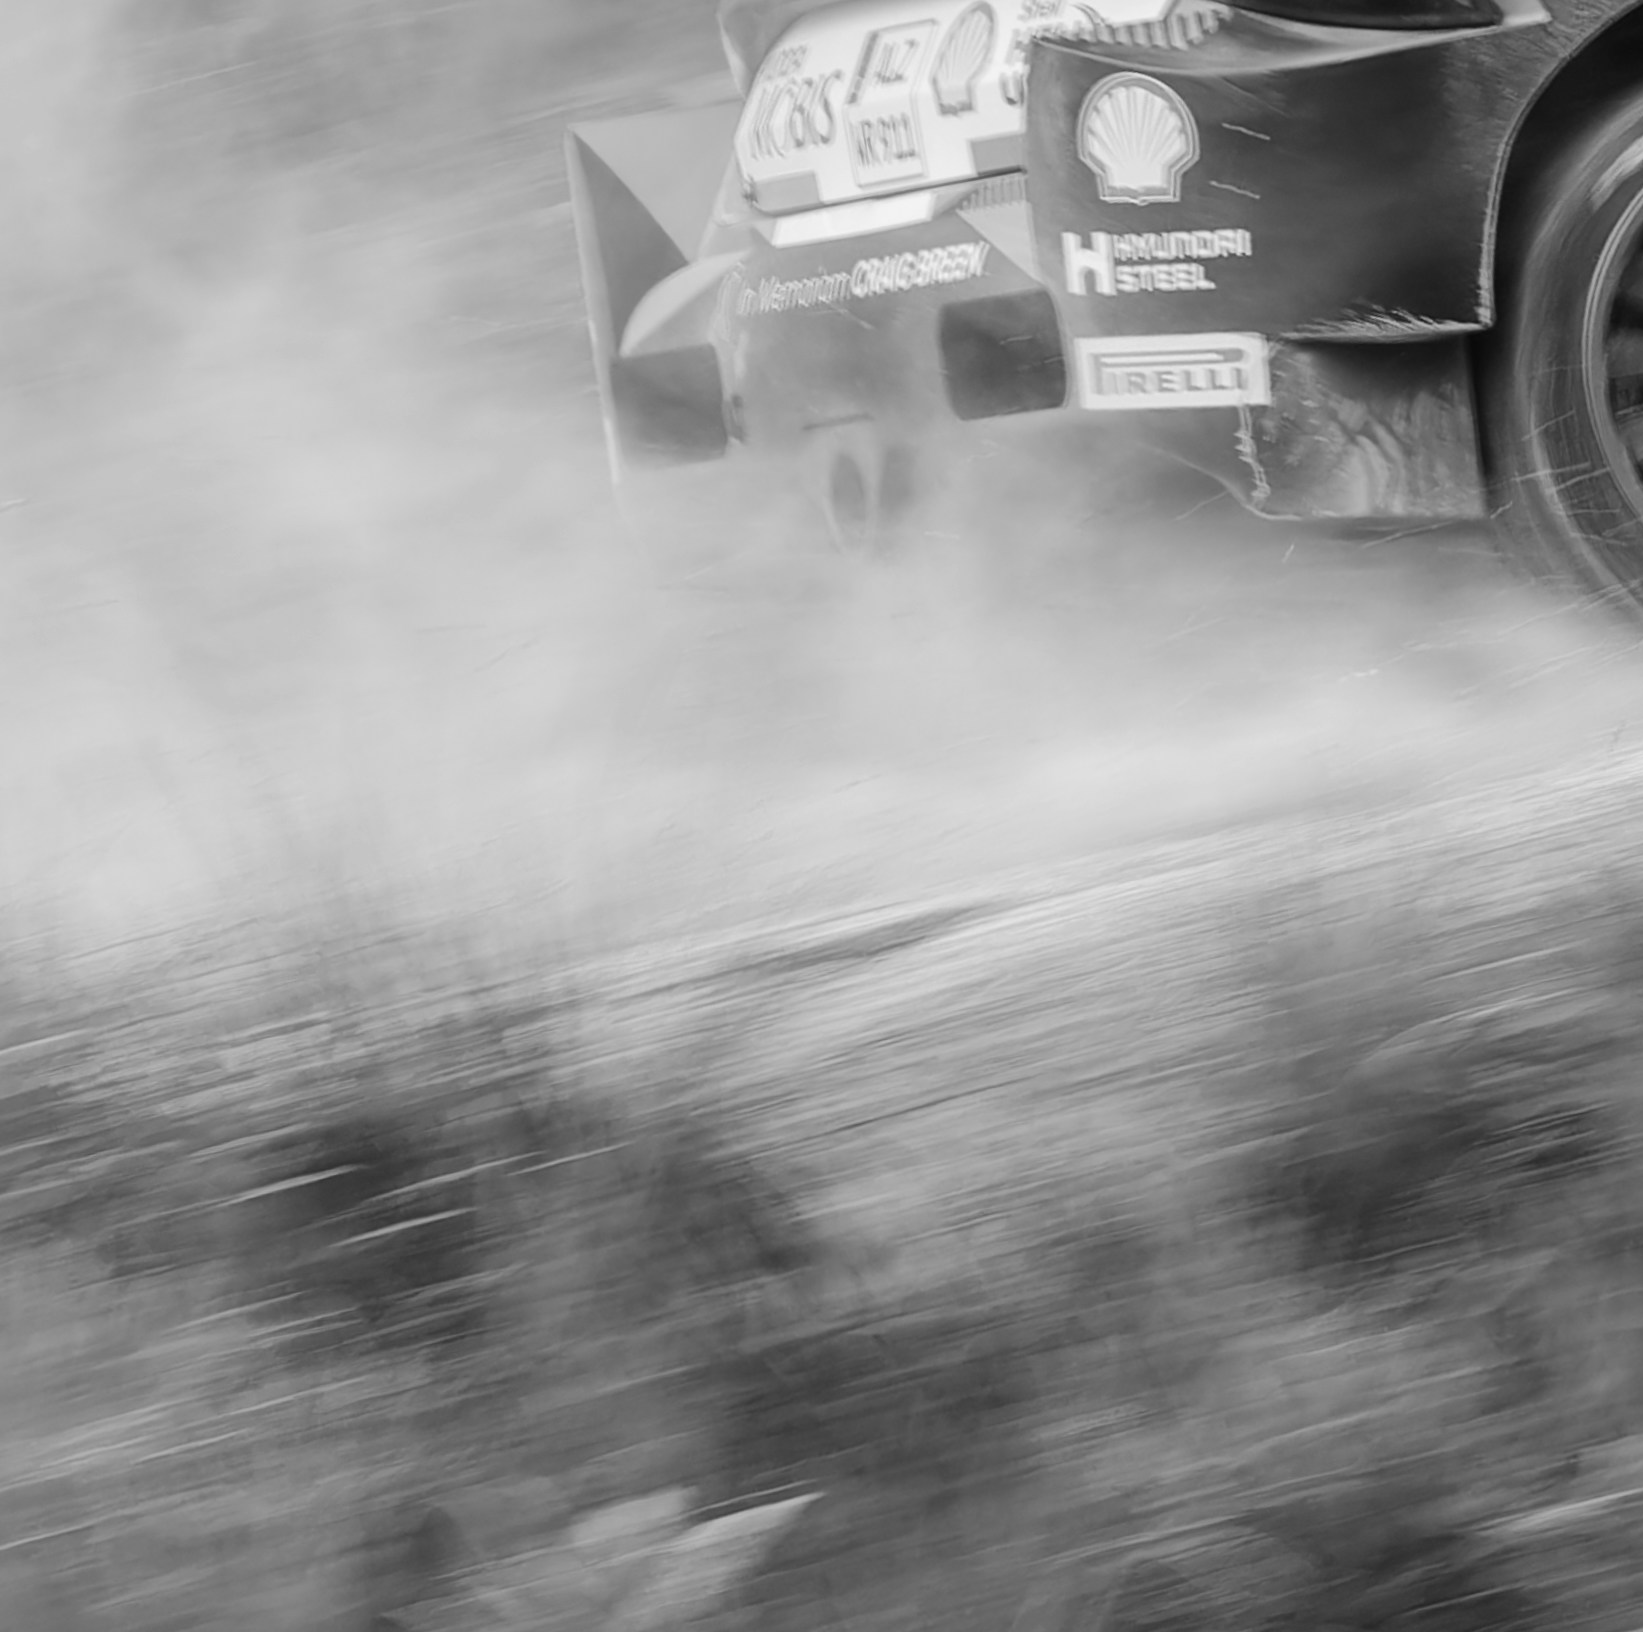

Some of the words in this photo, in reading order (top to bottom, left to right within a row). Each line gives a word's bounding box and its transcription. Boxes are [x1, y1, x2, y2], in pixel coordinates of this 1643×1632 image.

[1113, 228, 1252, 260] HYUNDAI
[850, 254, 916, 298] CRAIG
[1116, 262, 1216, 292] STEEL
